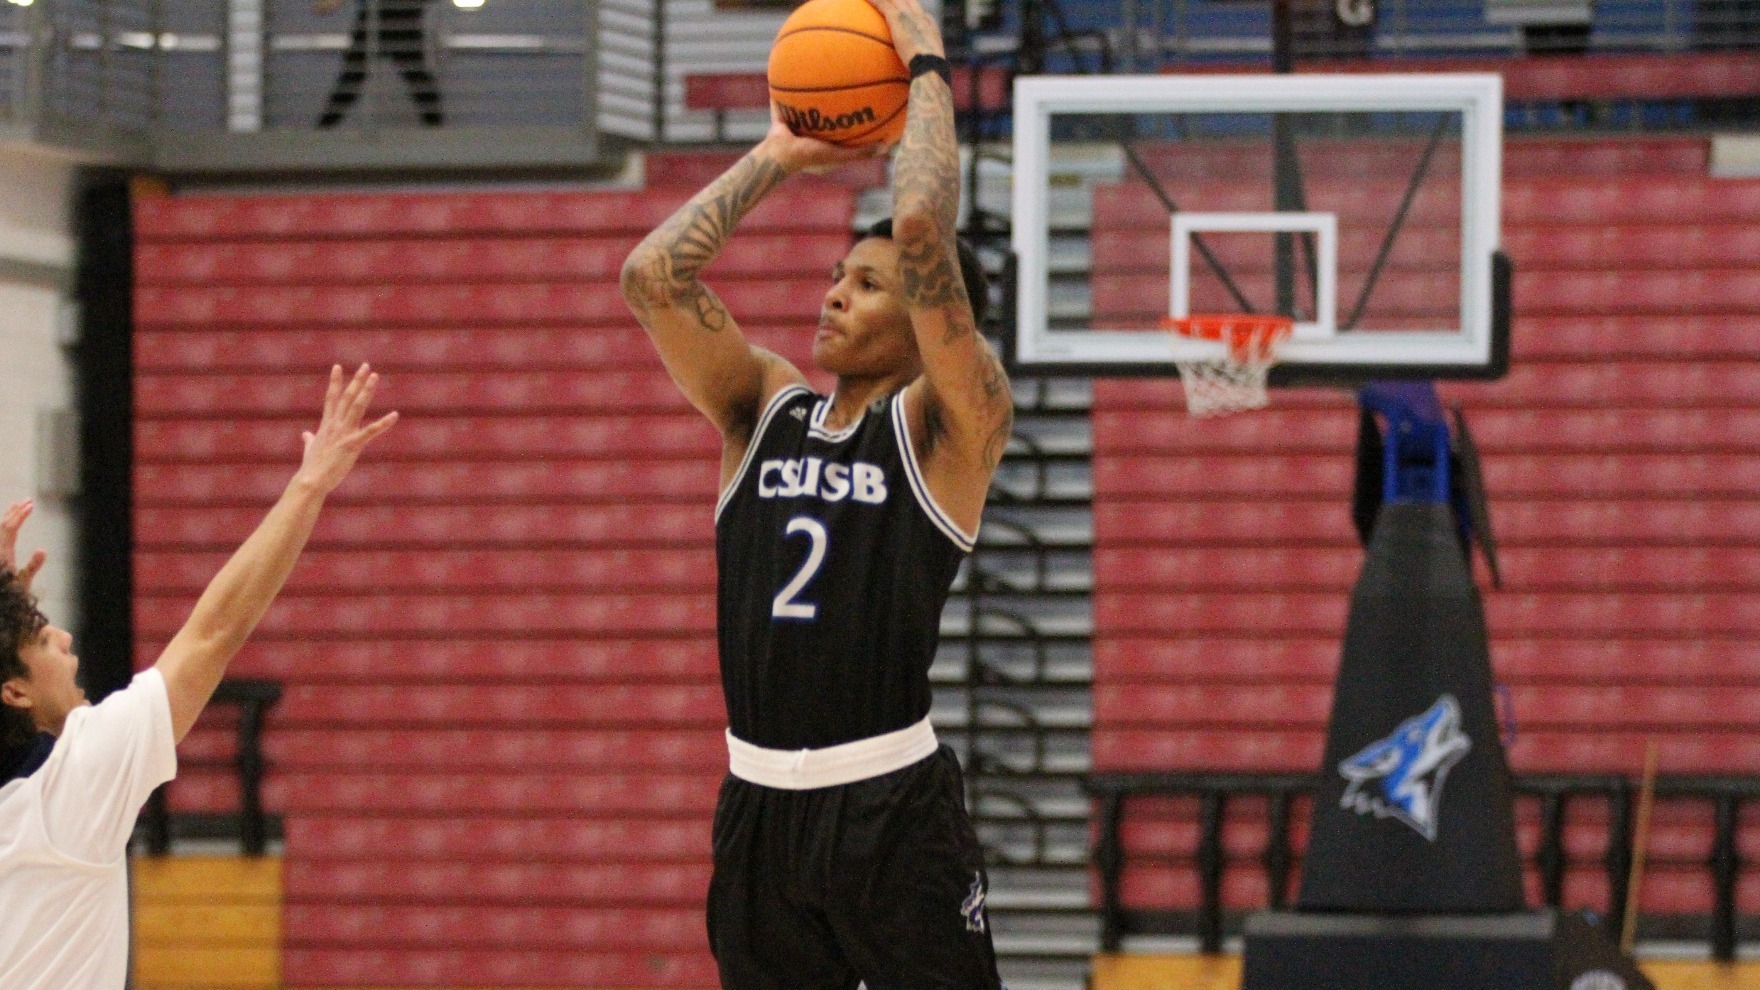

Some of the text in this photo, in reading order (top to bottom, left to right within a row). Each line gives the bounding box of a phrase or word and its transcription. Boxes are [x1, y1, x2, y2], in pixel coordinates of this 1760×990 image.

[777, 102, 875, 136] Wilson
[758, 457, 888, 504] CSUSB
[772, 516, 828, 618] 2
